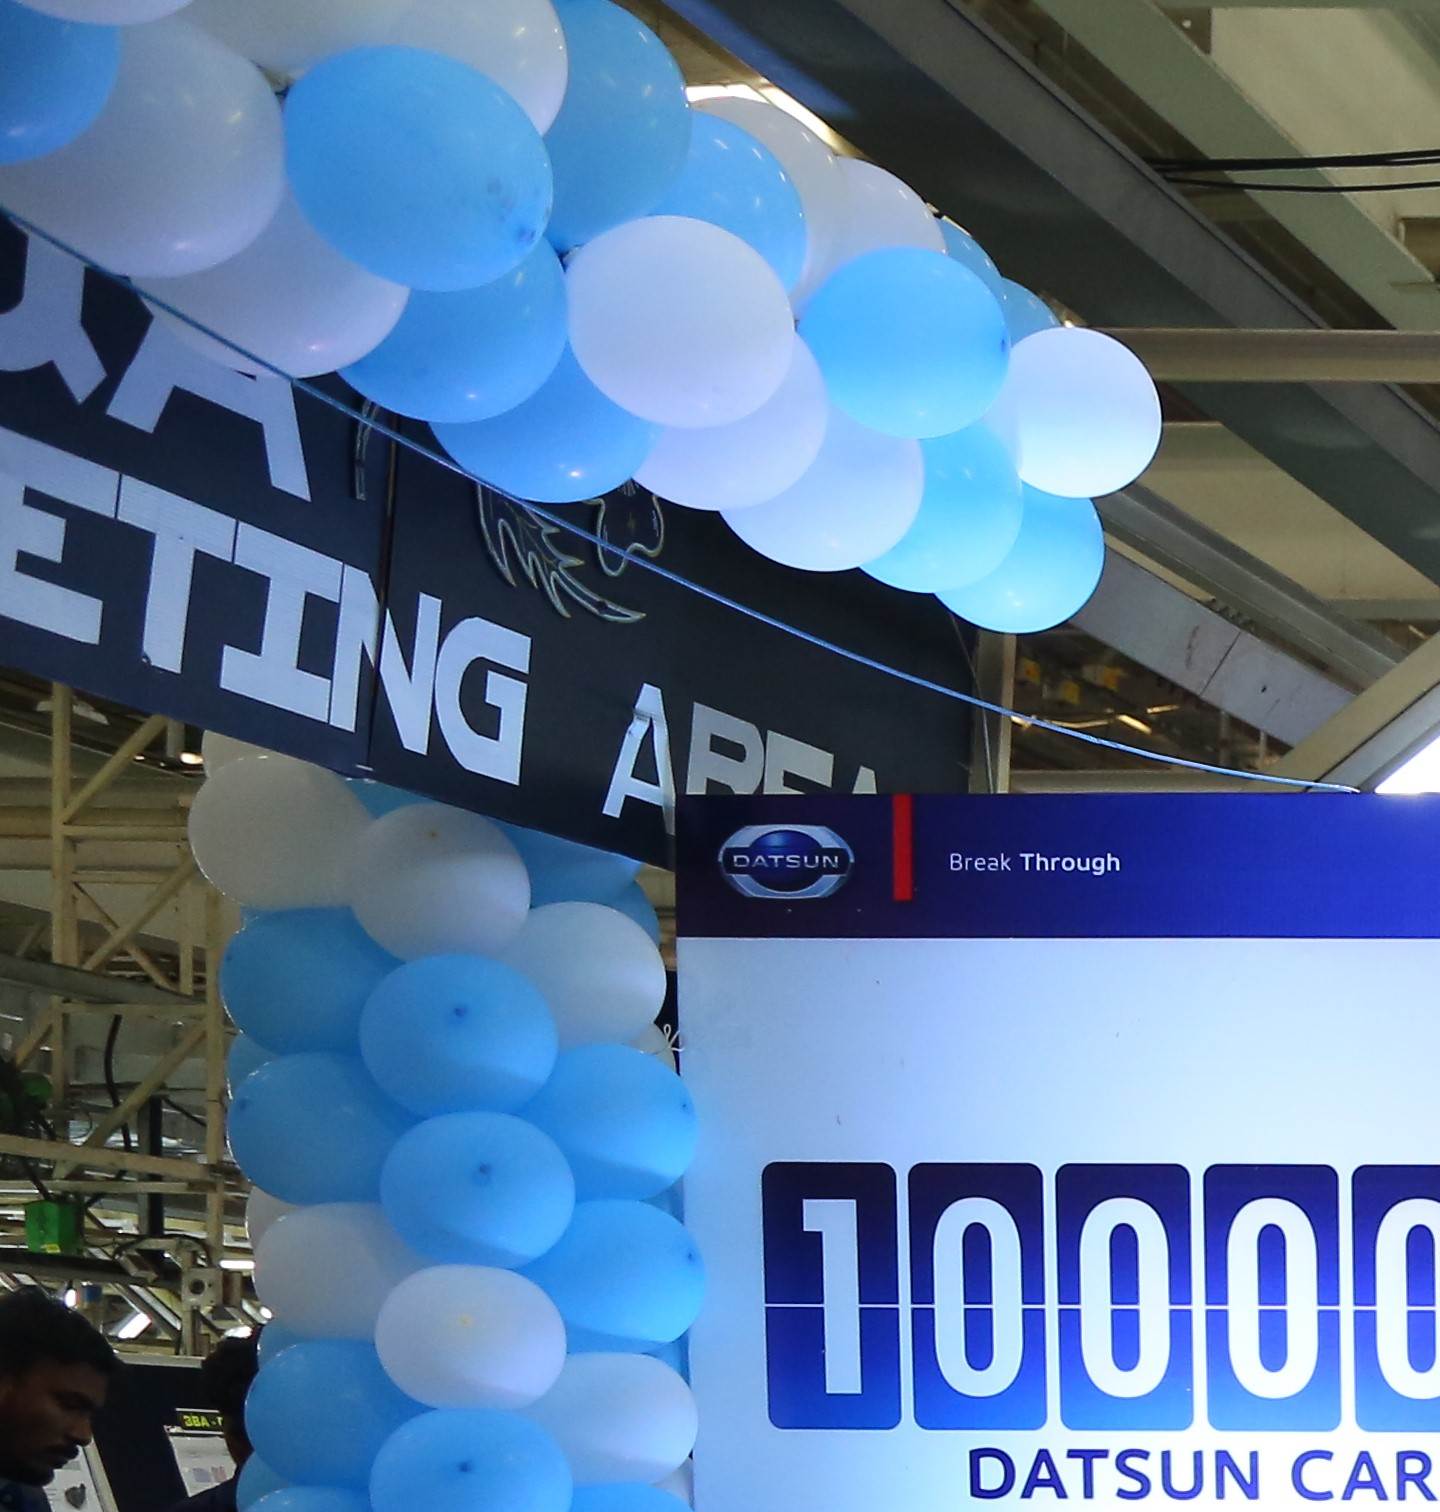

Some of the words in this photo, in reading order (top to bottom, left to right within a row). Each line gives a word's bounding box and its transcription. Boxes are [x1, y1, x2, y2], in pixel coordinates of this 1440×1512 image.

[733, 854, 839, 869] DATSUN
[949, 852, 1011, 873] Break
[1019, 852, 1121, 876] Through
[968, 1446, 1259, 1502] DATSUN
[1290, 1448, 1438, 1503] CAR
